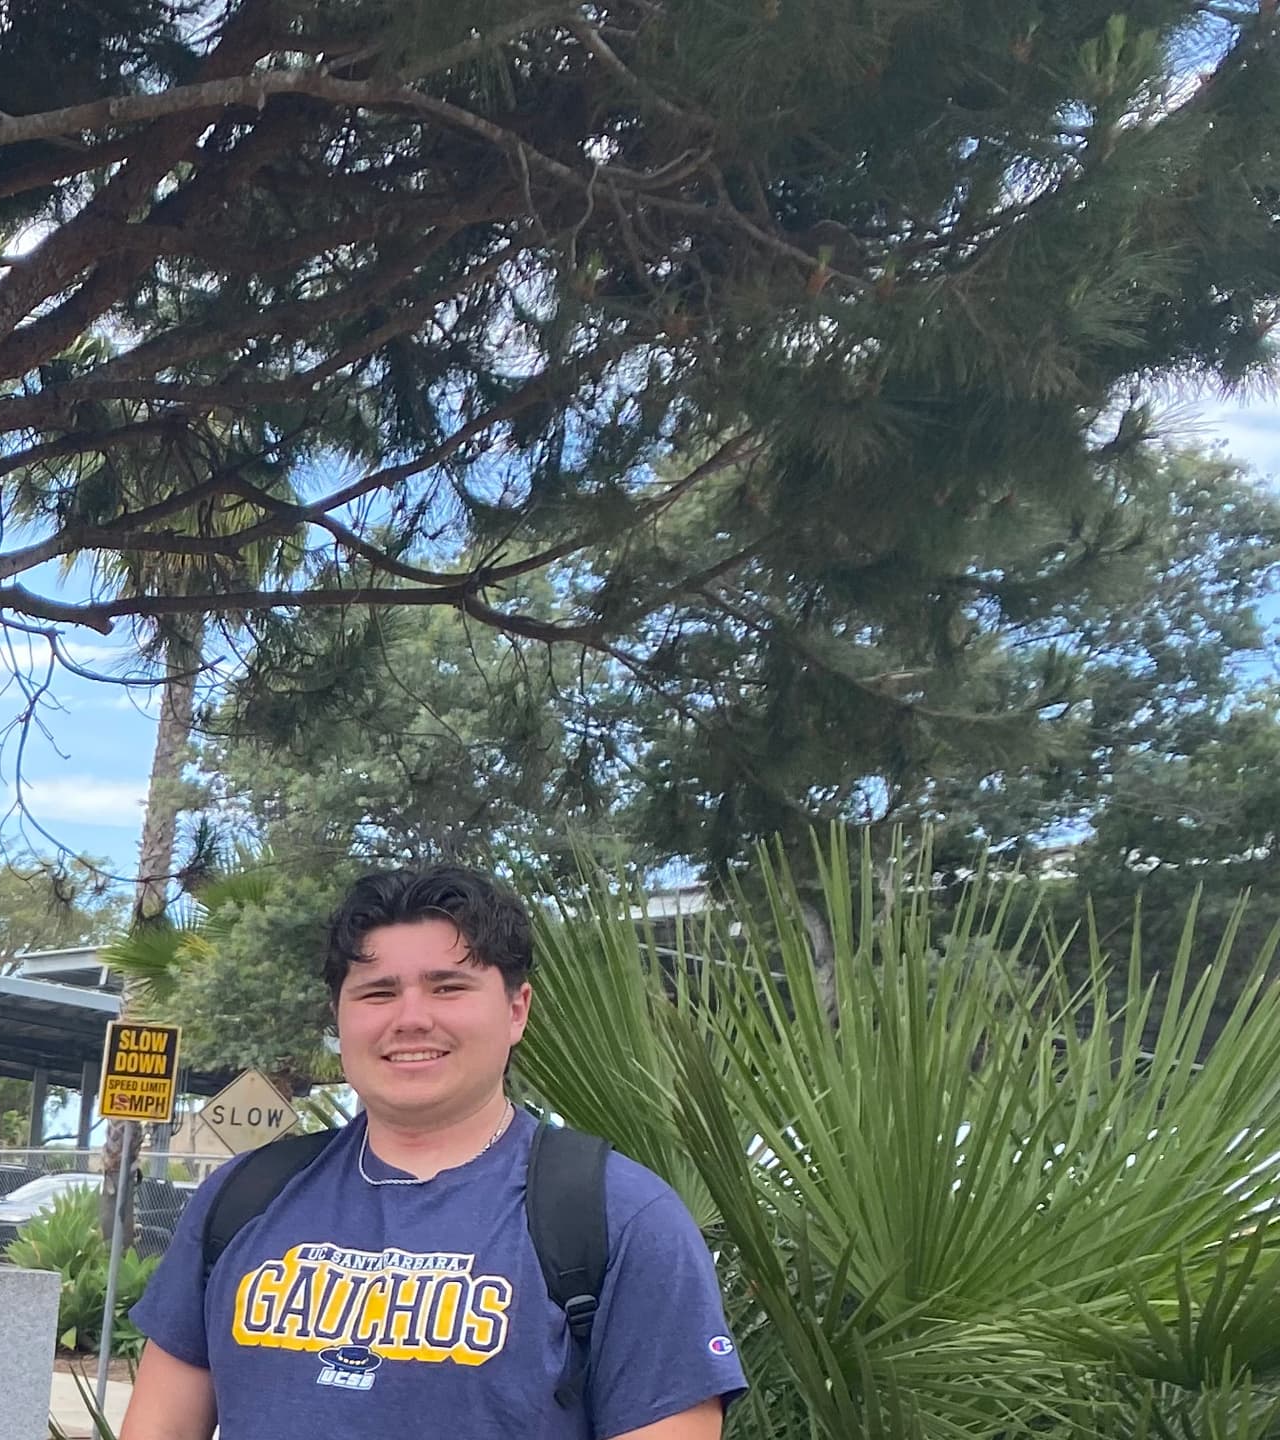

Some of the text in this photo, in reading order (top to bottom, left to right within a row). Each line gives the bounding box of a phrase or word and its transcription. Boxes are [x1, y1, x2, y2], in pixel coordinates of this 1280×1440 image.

[118, 1029, 169, 1053] SLOW
[114, 1051, 167, 1075] DOWN
[109, 1079, 168, 1094] SPEED LIMIT
[109, 1092, 166, 1114] 1MPH
[212, 1105, 284, 1128] SLOW
[308, 1247, 328, 1260] UC
[330, 1250, 384, 1271] SANTA
[243, 1263, 511, 1353] GAUCHOS
[320, 1368, 375, 1388] UCSB
